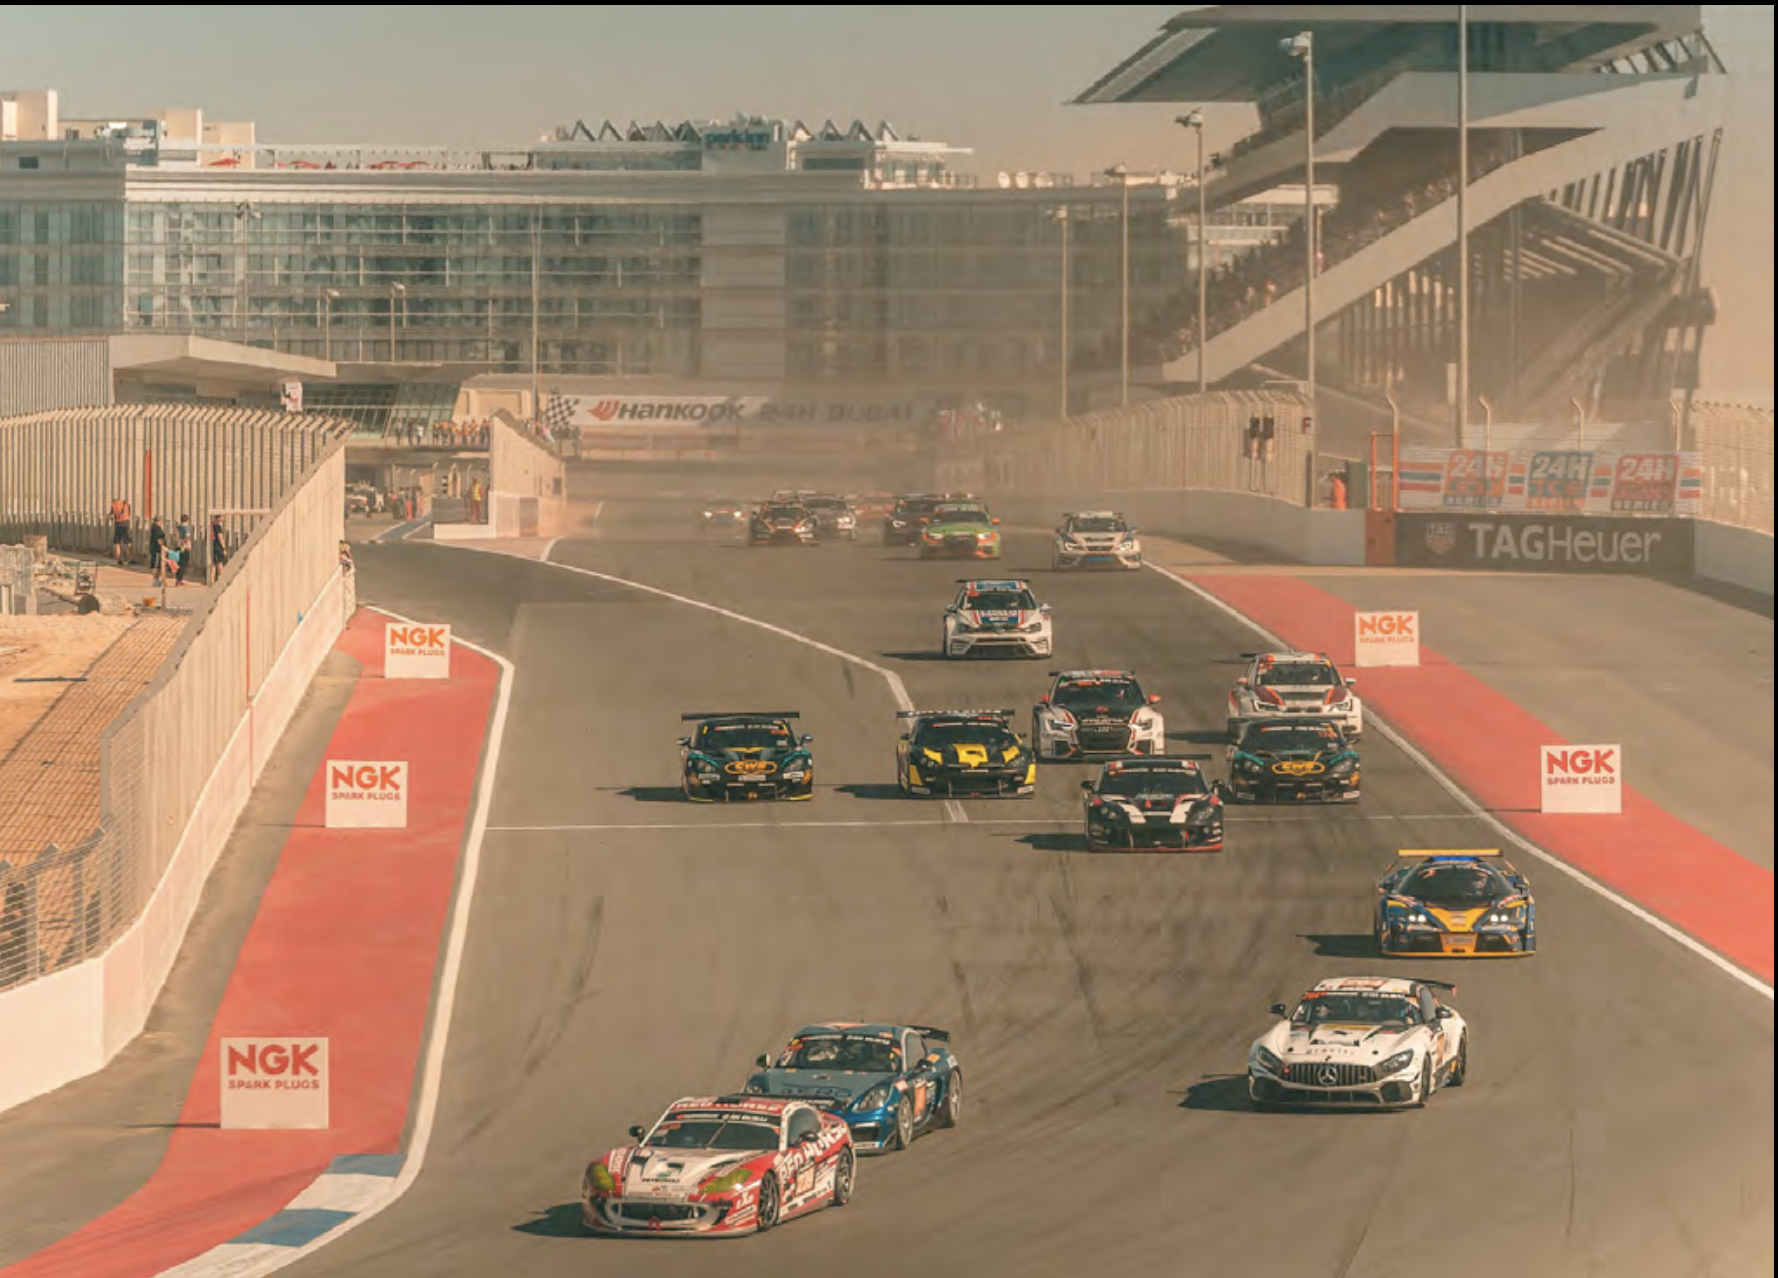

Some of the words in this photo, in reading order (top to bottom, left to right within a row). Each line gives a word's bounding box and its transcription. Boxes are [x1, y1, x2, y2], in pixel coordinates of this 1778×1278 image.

[1301, 416, 1312, 434] F
[1450, 455, 1503, 479] 24H
[1533, 456, 1588, 479] 24H
[1619, 459, 1676, 480] 24H
[1359, 615, 1413, 635] NGK
[390, 627, 445, 647] NGK
[1547, 749, 1615, 774] NGK
[332, 766, 400, 790] NGK
[1547, 776, 1580, 785] SPARK
[1582, 776, 1615, 785] PLUGS
[228, 1044, 319, 1076] NGK
[228, 1079, 271, 1089] SPARK
[275, 1079, 319, 1089] PLUGS
